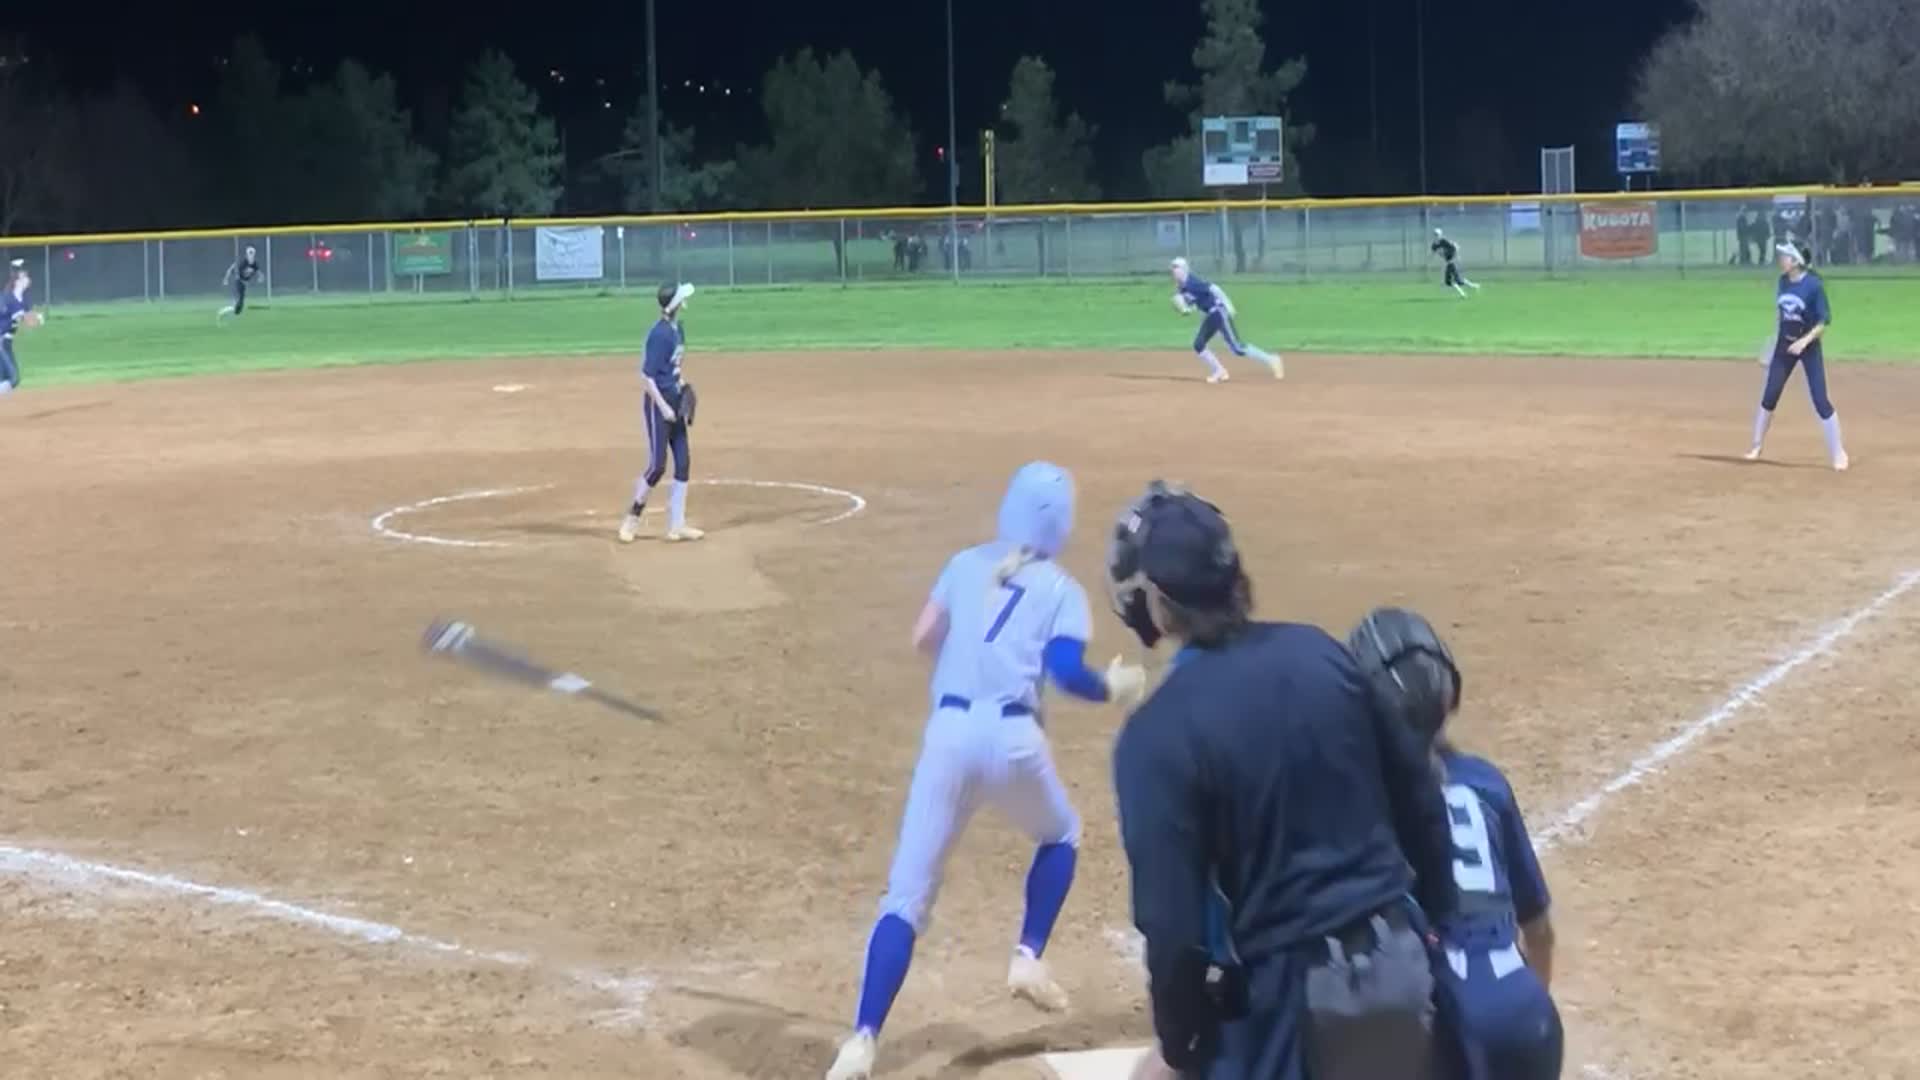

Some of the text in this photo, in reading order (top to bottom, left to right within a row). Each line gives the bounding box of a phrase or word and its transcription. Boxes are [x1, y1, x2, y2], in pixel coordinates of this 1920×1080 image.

[1583, 210, 1651, 231] KUBOTA
[984, 579, 1026, 643] 7
[1441, 784, 1496, 893] 9
